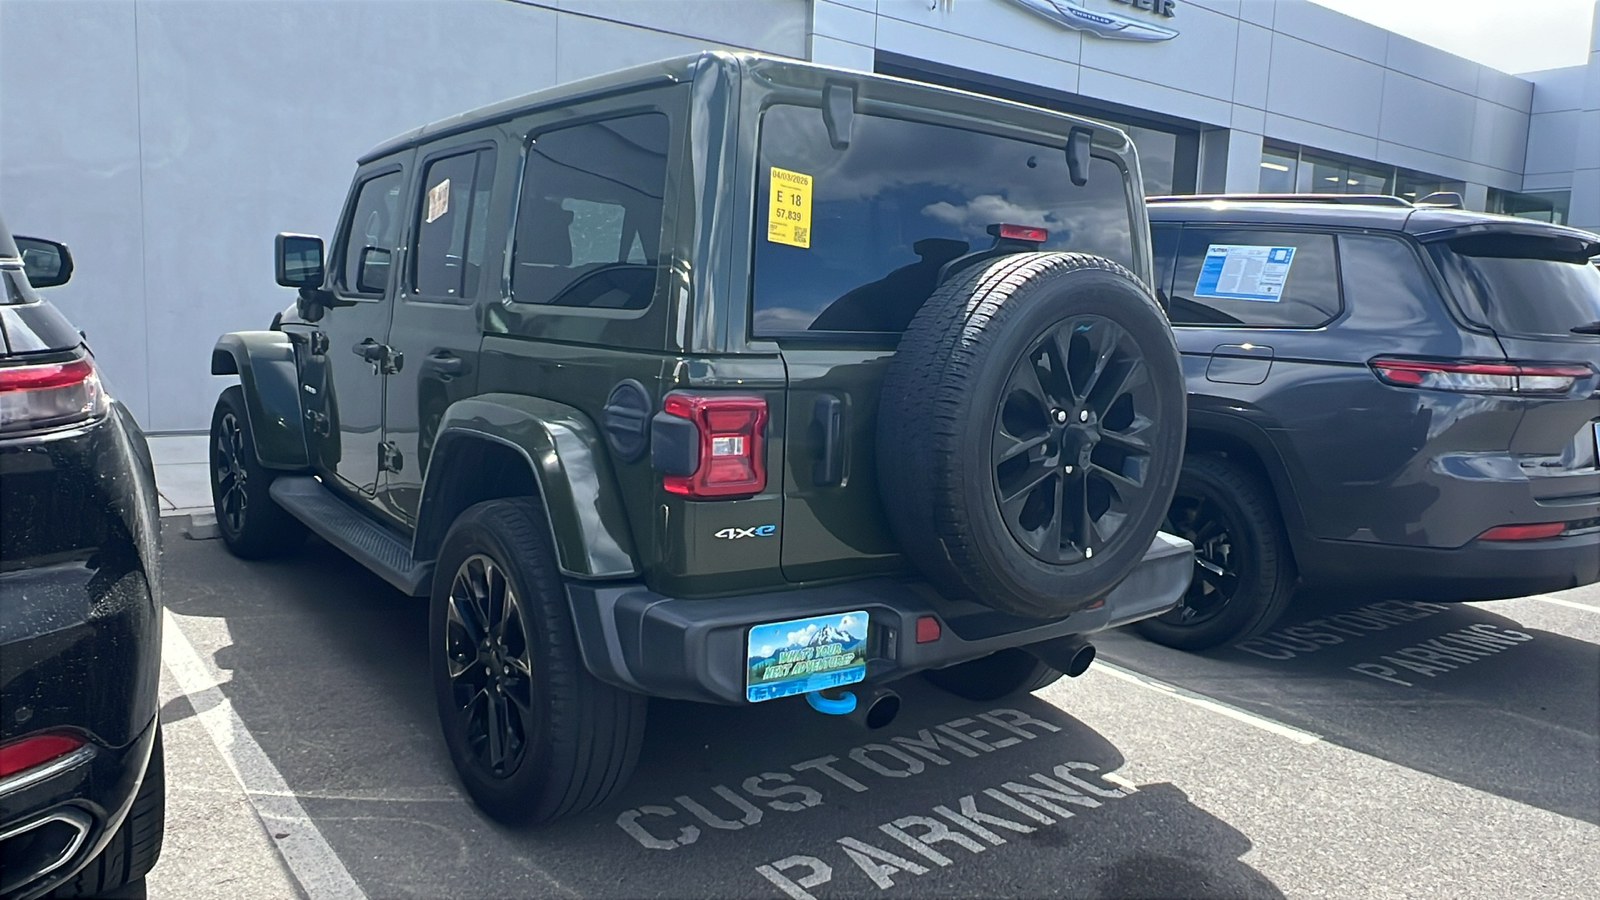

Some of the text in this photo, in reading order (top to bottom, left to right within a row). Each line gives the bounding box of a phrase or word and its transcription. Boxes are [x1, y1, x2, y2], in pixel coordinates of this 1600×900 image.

[1072, 10, 1110, 24] CHRYSLER
[777, 190, 801, 207] E 18
[776, 208, 801, 221] 57,839
[779, 643, 842, 663] WHAT'S YOUR
[1348, 623, 1534, 686] PARKING
[763, 653, 855, 680] NEXT ADVENTURE?
[616, 708, 1062, 850] CUSTOMER
[755, 761, 1139, 900] PARKING
